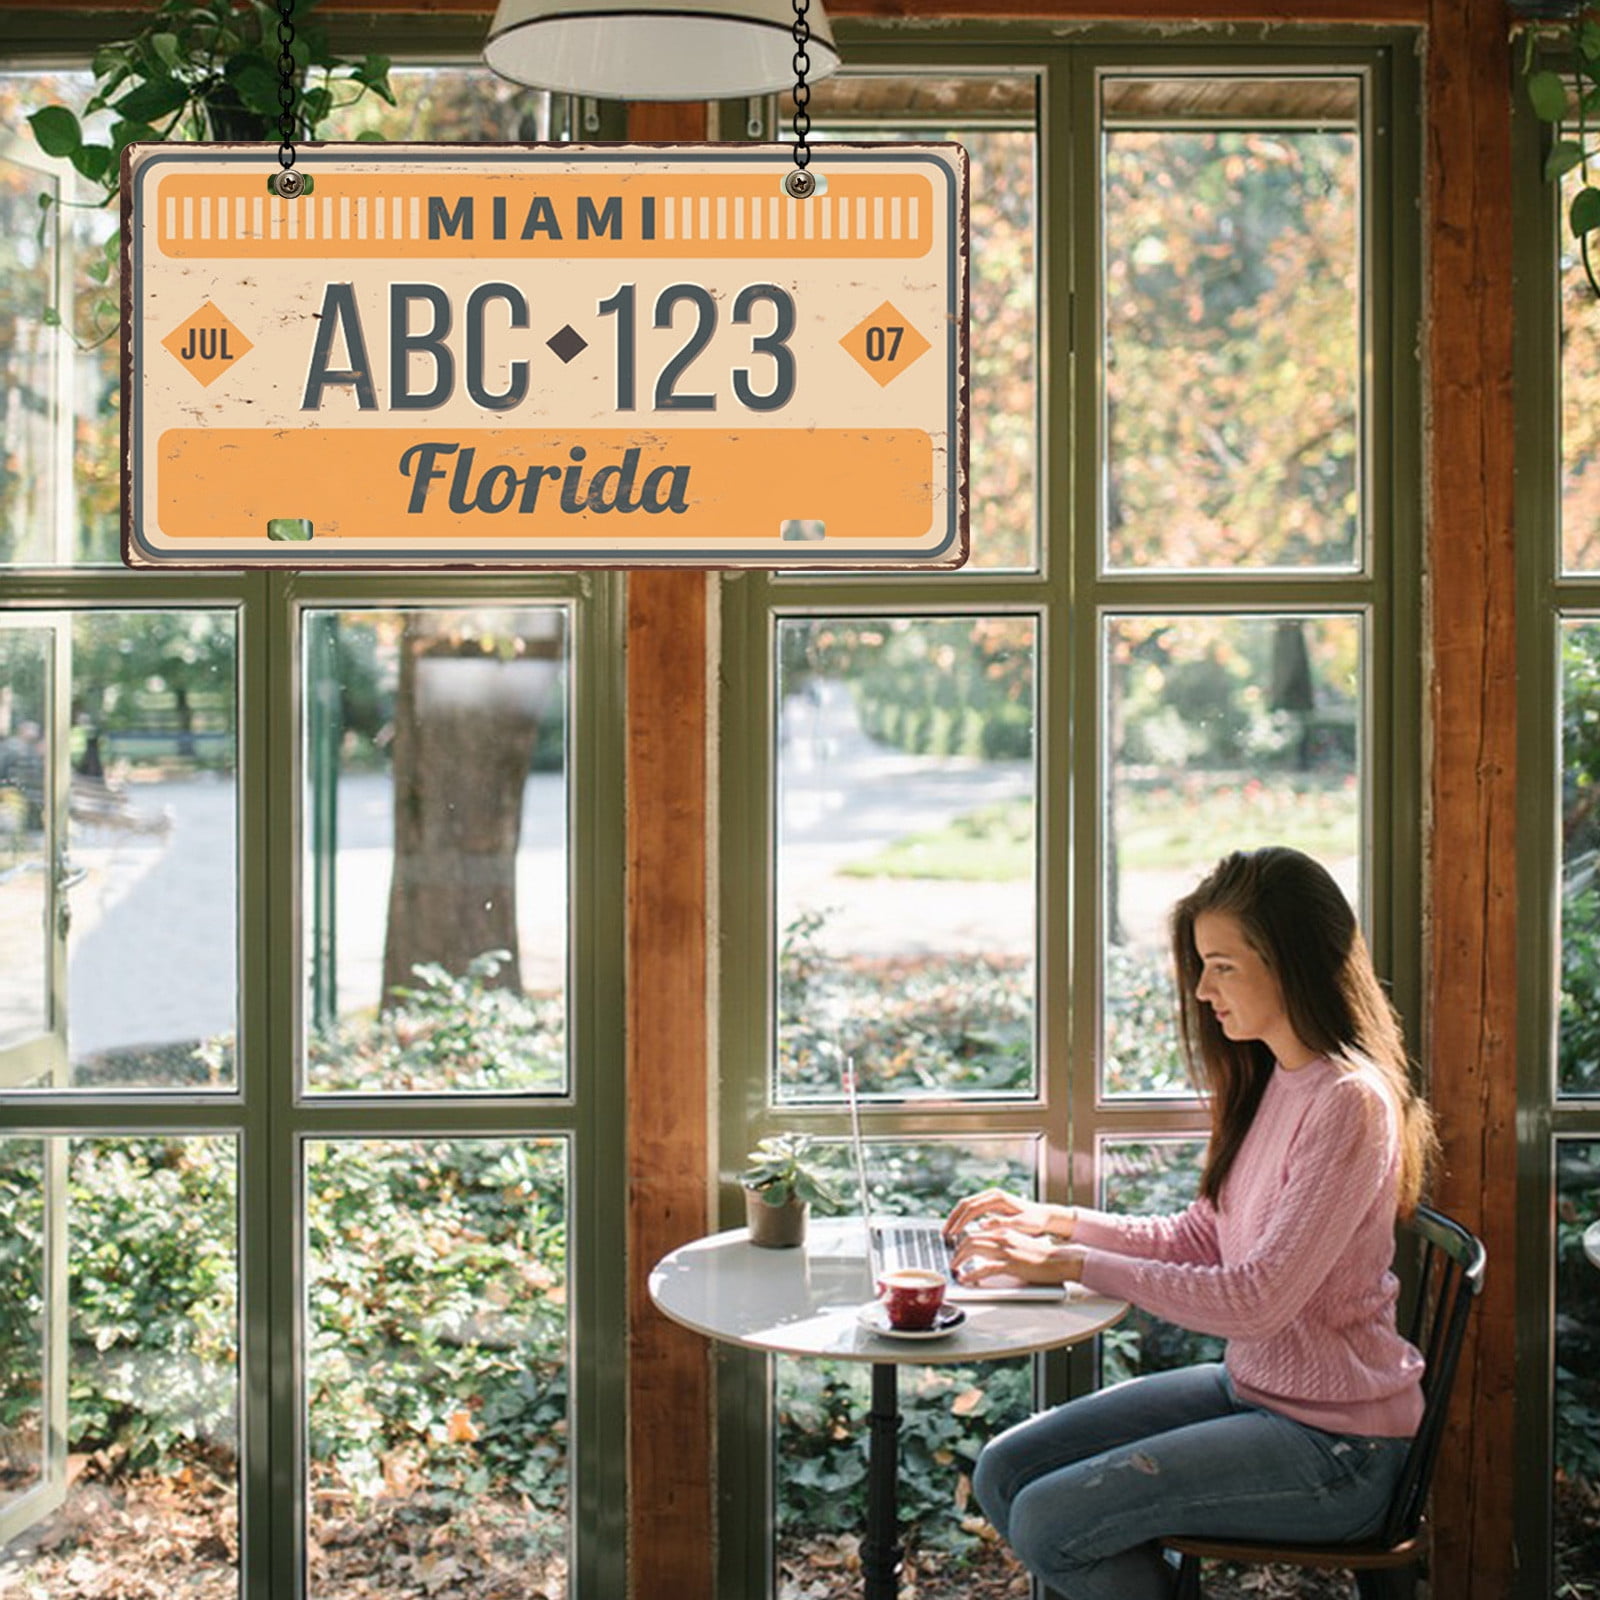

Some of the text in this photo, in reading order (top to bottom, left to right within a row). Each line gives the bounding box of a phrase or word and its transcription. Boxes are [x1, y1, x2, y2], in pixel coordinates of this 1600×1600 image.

[428, 196, 656, 241] MIAMI
[181, 328, 234, 362] JUL
[866, 326, 904, 362] 07
[399, 442, 691, 515] Florida
